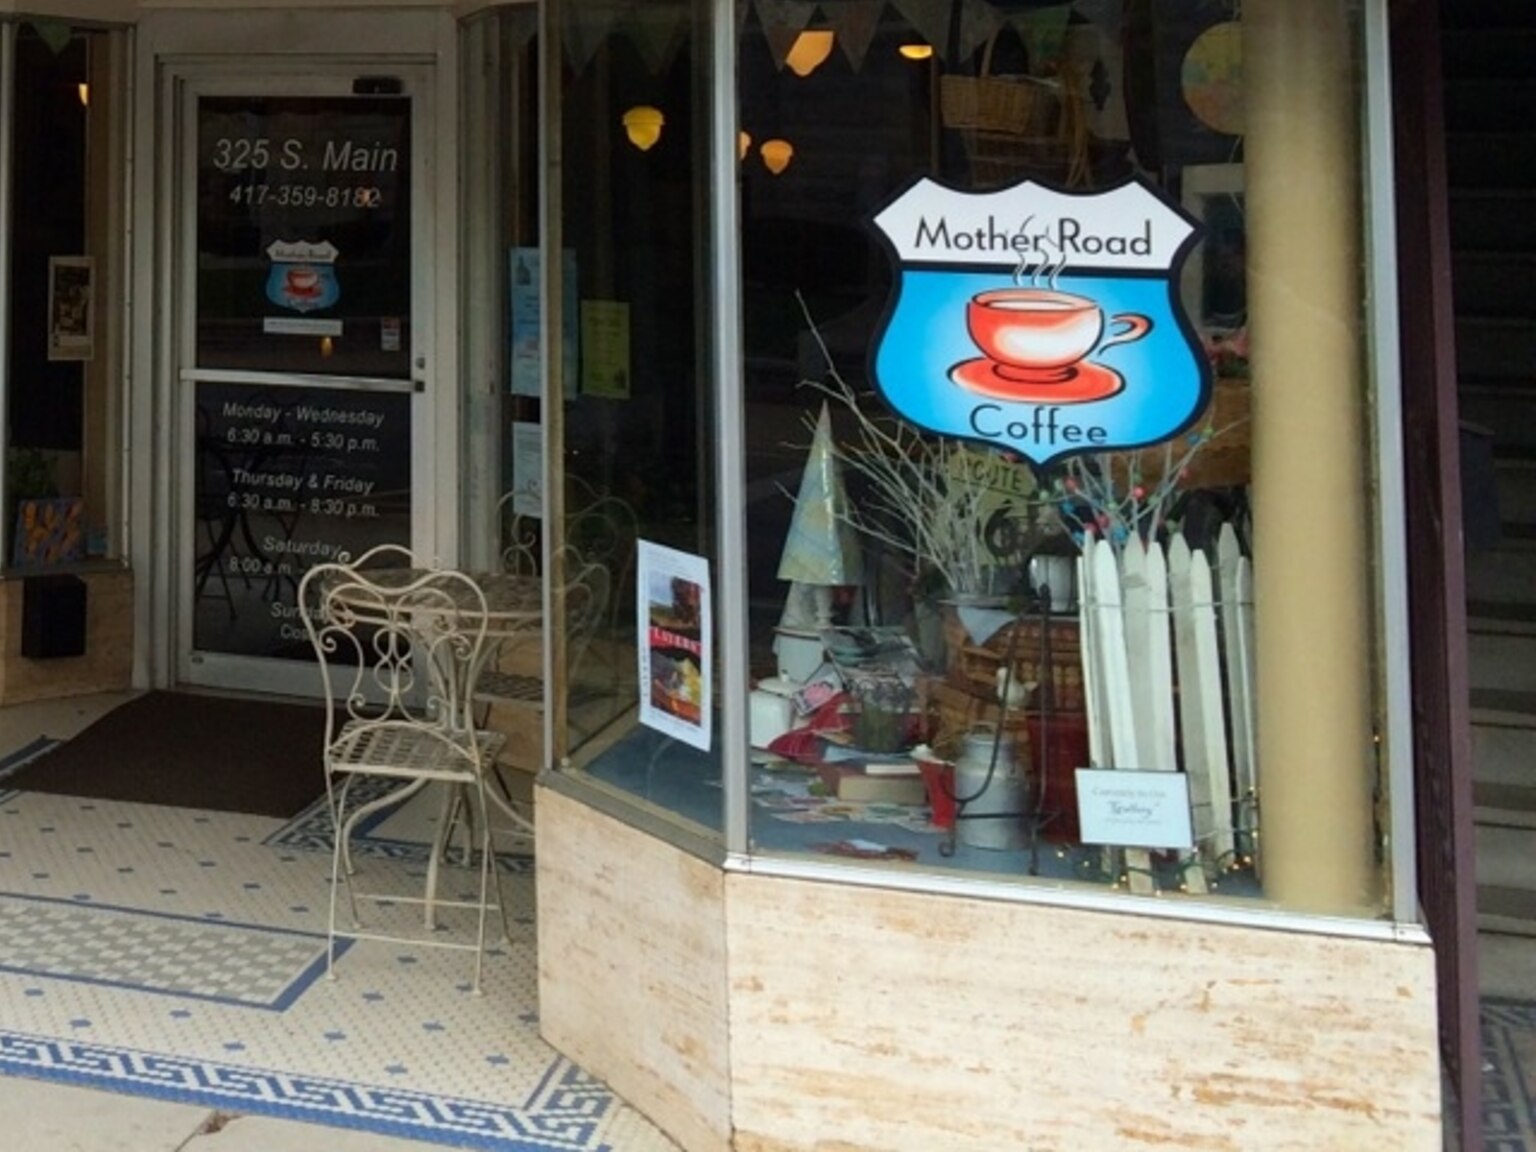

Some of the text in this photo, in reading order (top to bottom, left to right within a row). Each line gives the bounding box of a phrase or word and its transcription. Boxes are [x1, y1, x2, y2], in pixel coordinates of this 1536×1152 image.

[214, 138, 398, 172] 325 S. Main
[914, 215, 1152, 255] Mother Road
[223, 403, 282, 423] Monday
[296, 406, 385, 429] Wednesday
[969, 404, 1107, 444] Coffee
[227, 428, 260, 444] 6:30
[311, 434, 345, 448] 5:30
[232, 469, 375, 495] Thursday & Friday
[264, 536, 342, 559] Saturday
